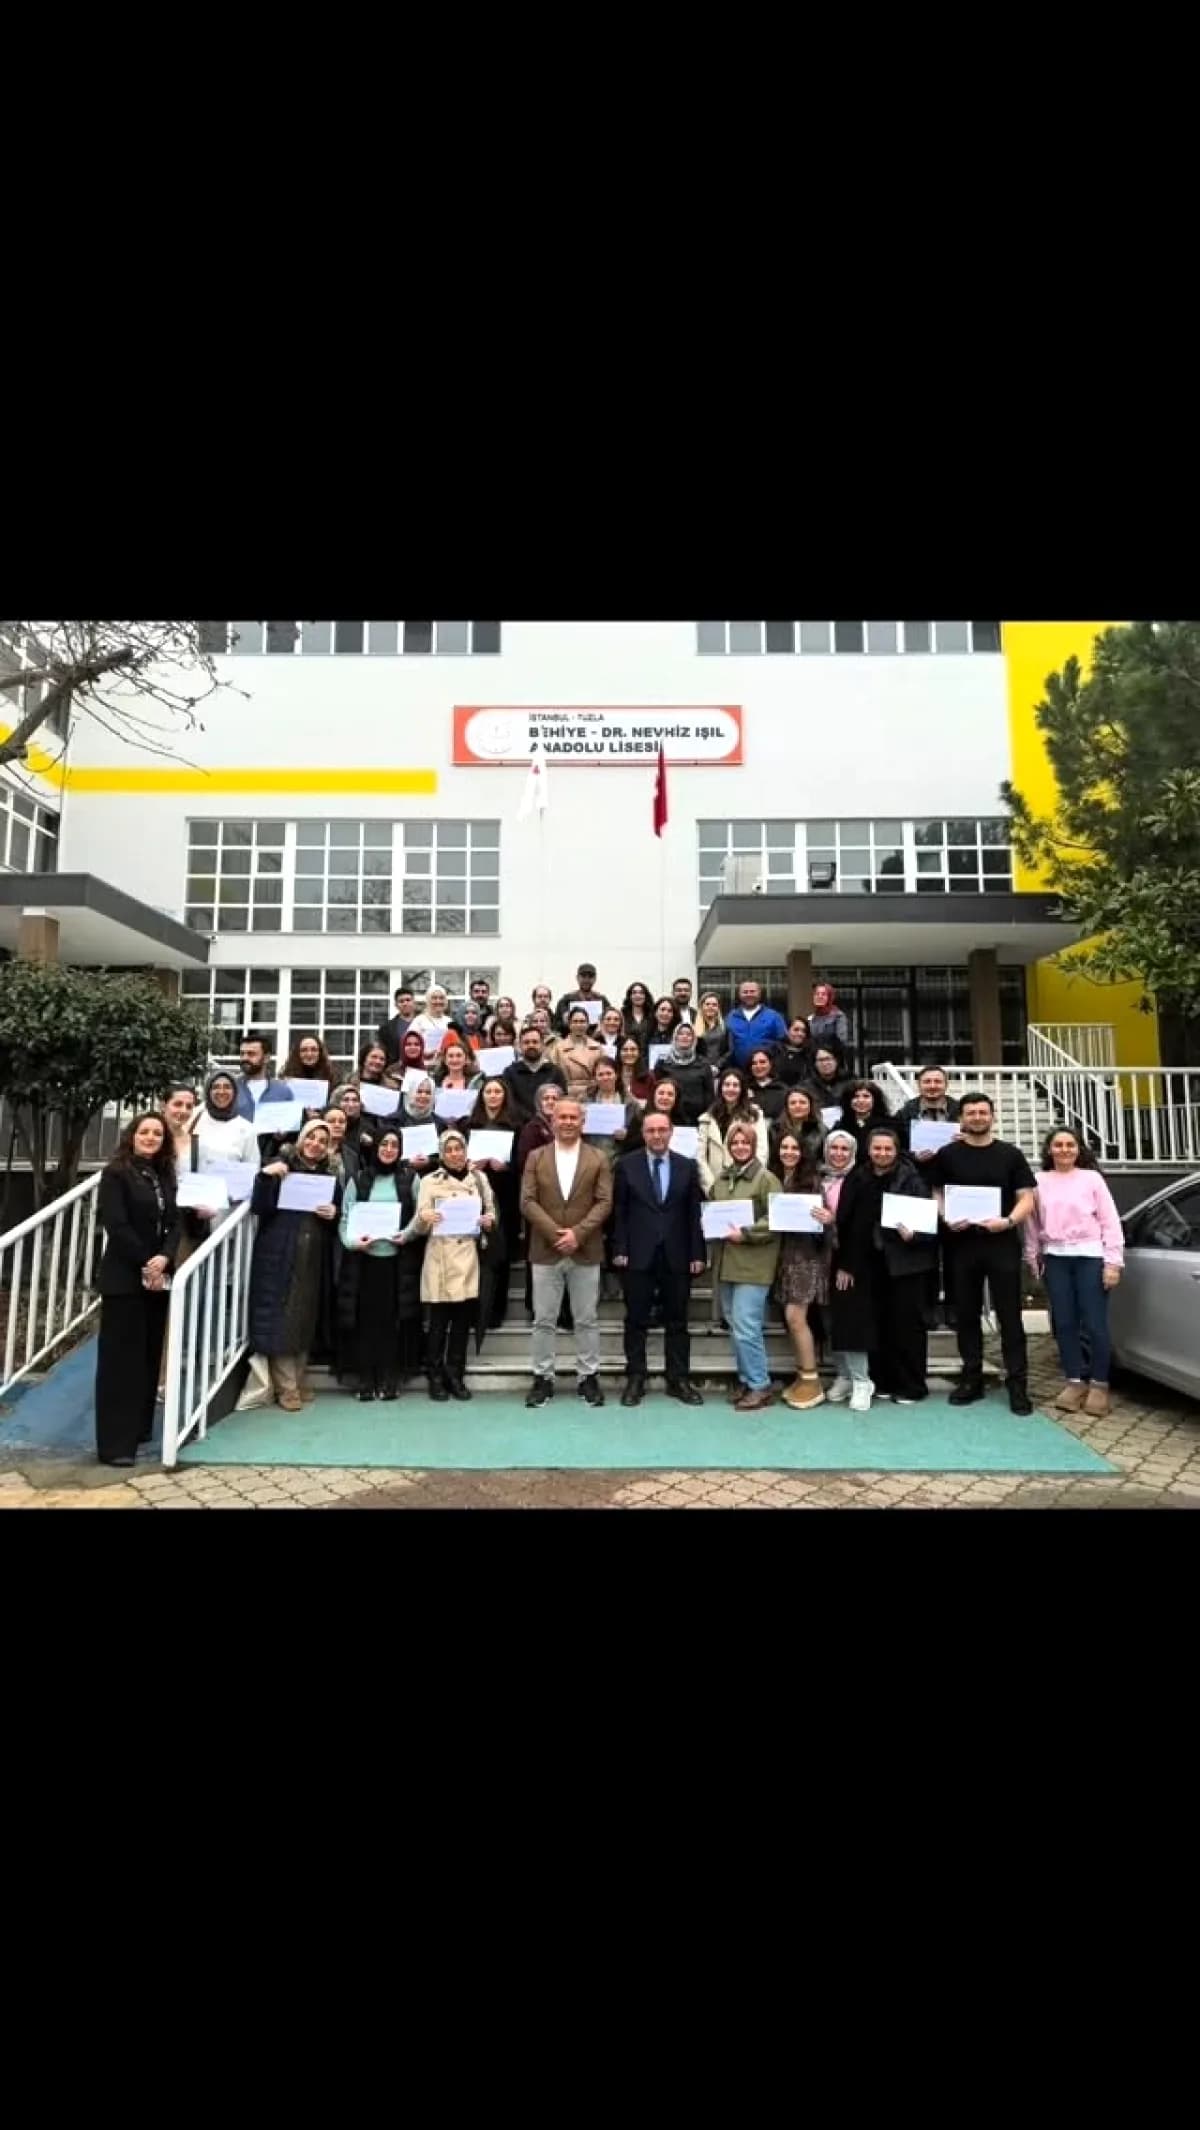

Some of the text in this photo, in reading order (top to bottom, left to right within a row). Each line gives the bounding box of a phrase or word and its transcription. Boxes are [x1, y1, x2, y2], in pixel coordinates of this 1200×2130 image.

[602, 726, 627, 738] DR.
[632, 724, 691, 738] NEVHİZ
[695, 726, 725, 741] IŞIL
[528, 740, 658, 753] ANADOLU LİSESİ
